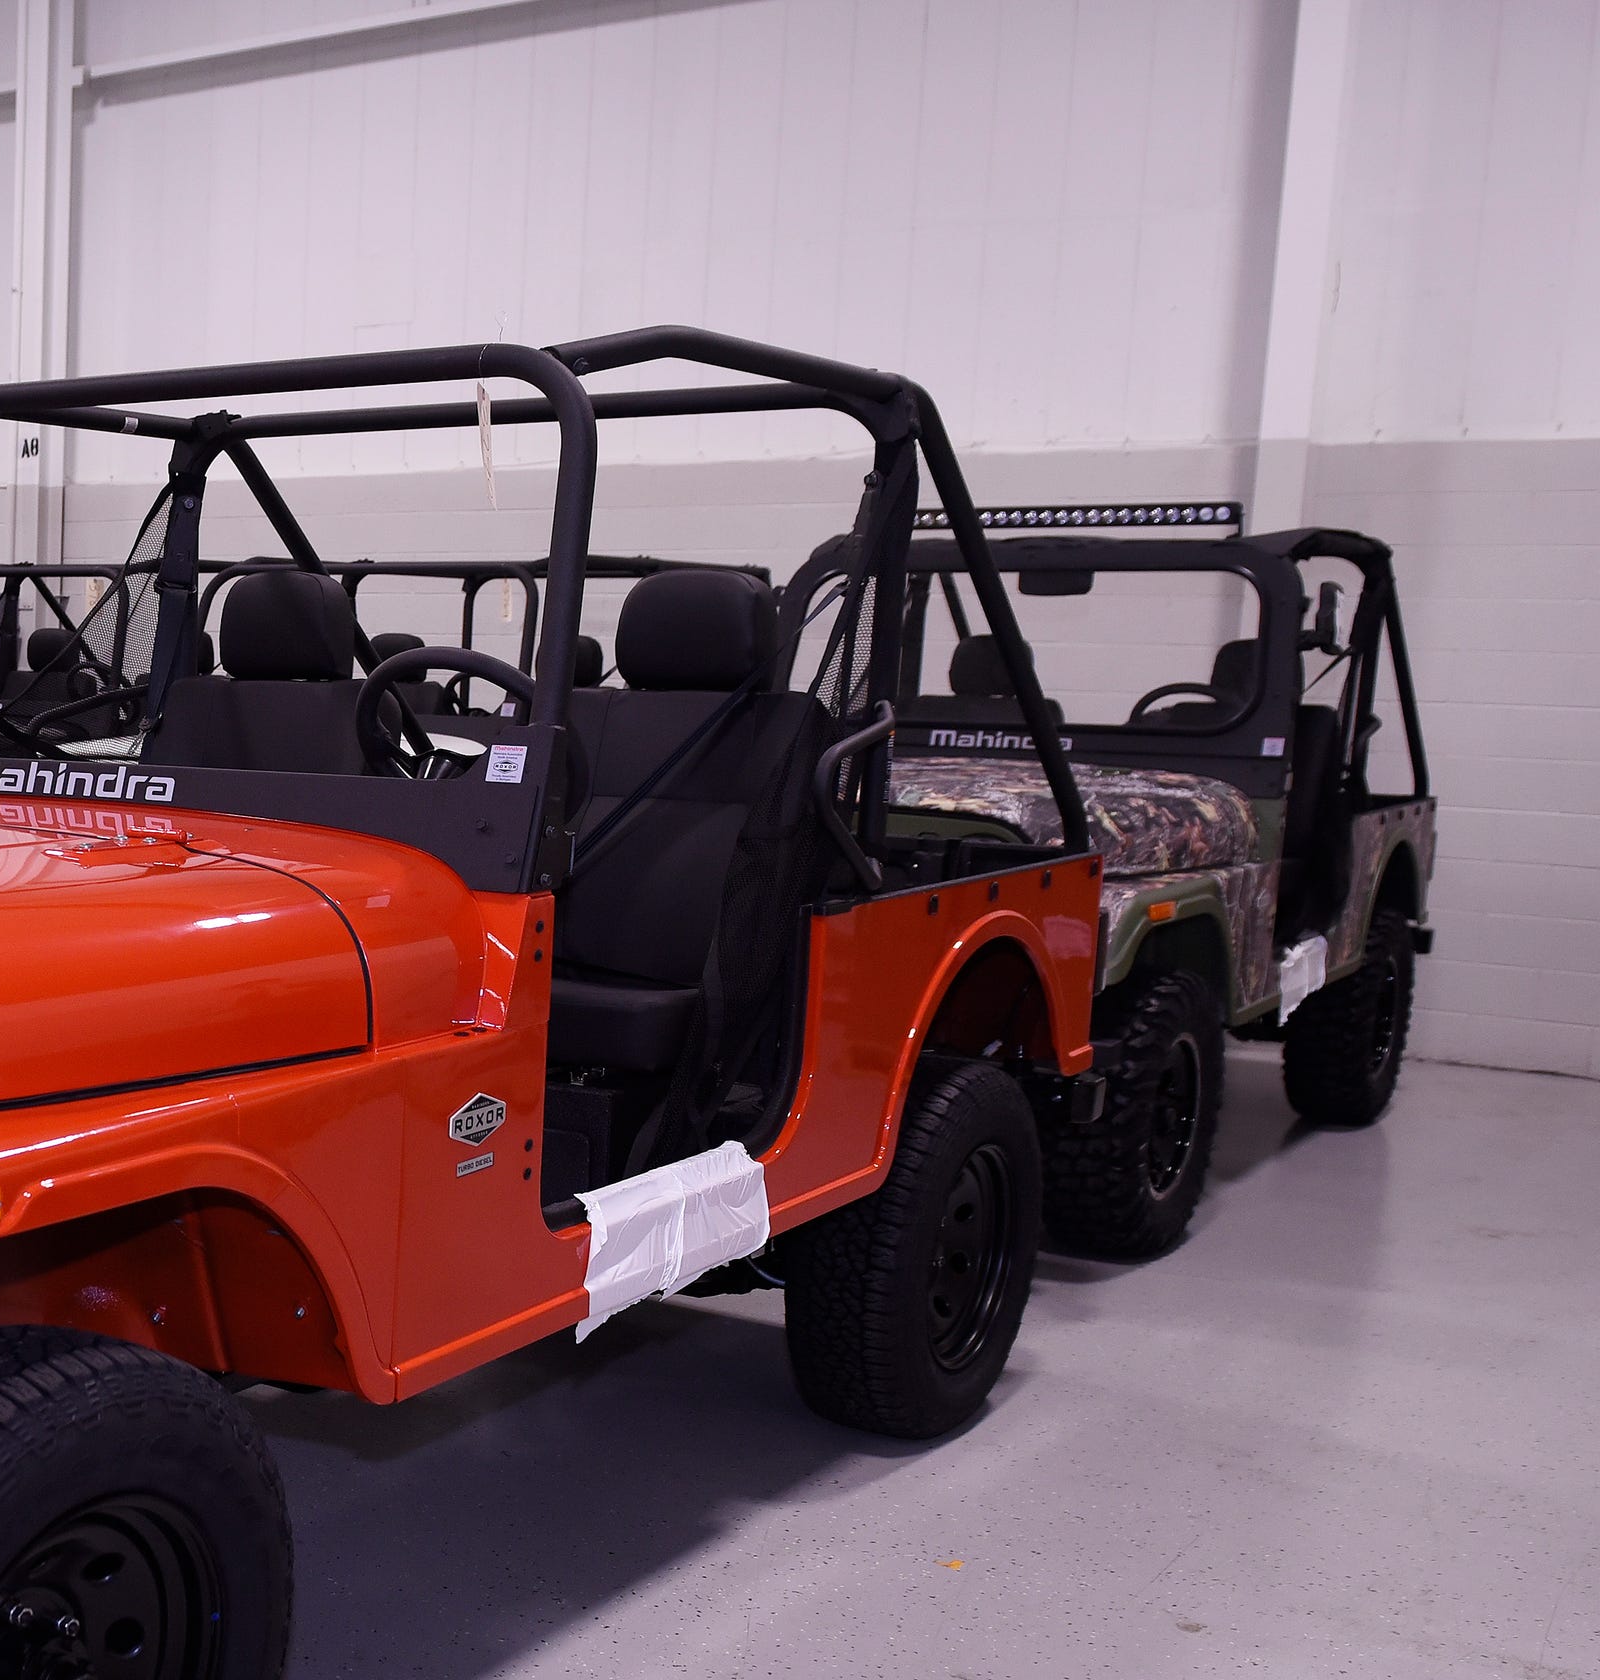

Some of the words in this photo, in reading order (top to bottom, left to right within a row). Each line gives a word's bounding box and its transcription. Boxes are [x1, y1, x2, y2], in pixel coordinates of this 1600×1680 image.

[454, 1106, 504, 1133] ROXOR
[458, 1162, 474, 1173] TURBO
[475, 1156, 492, 1167] DIESEL
